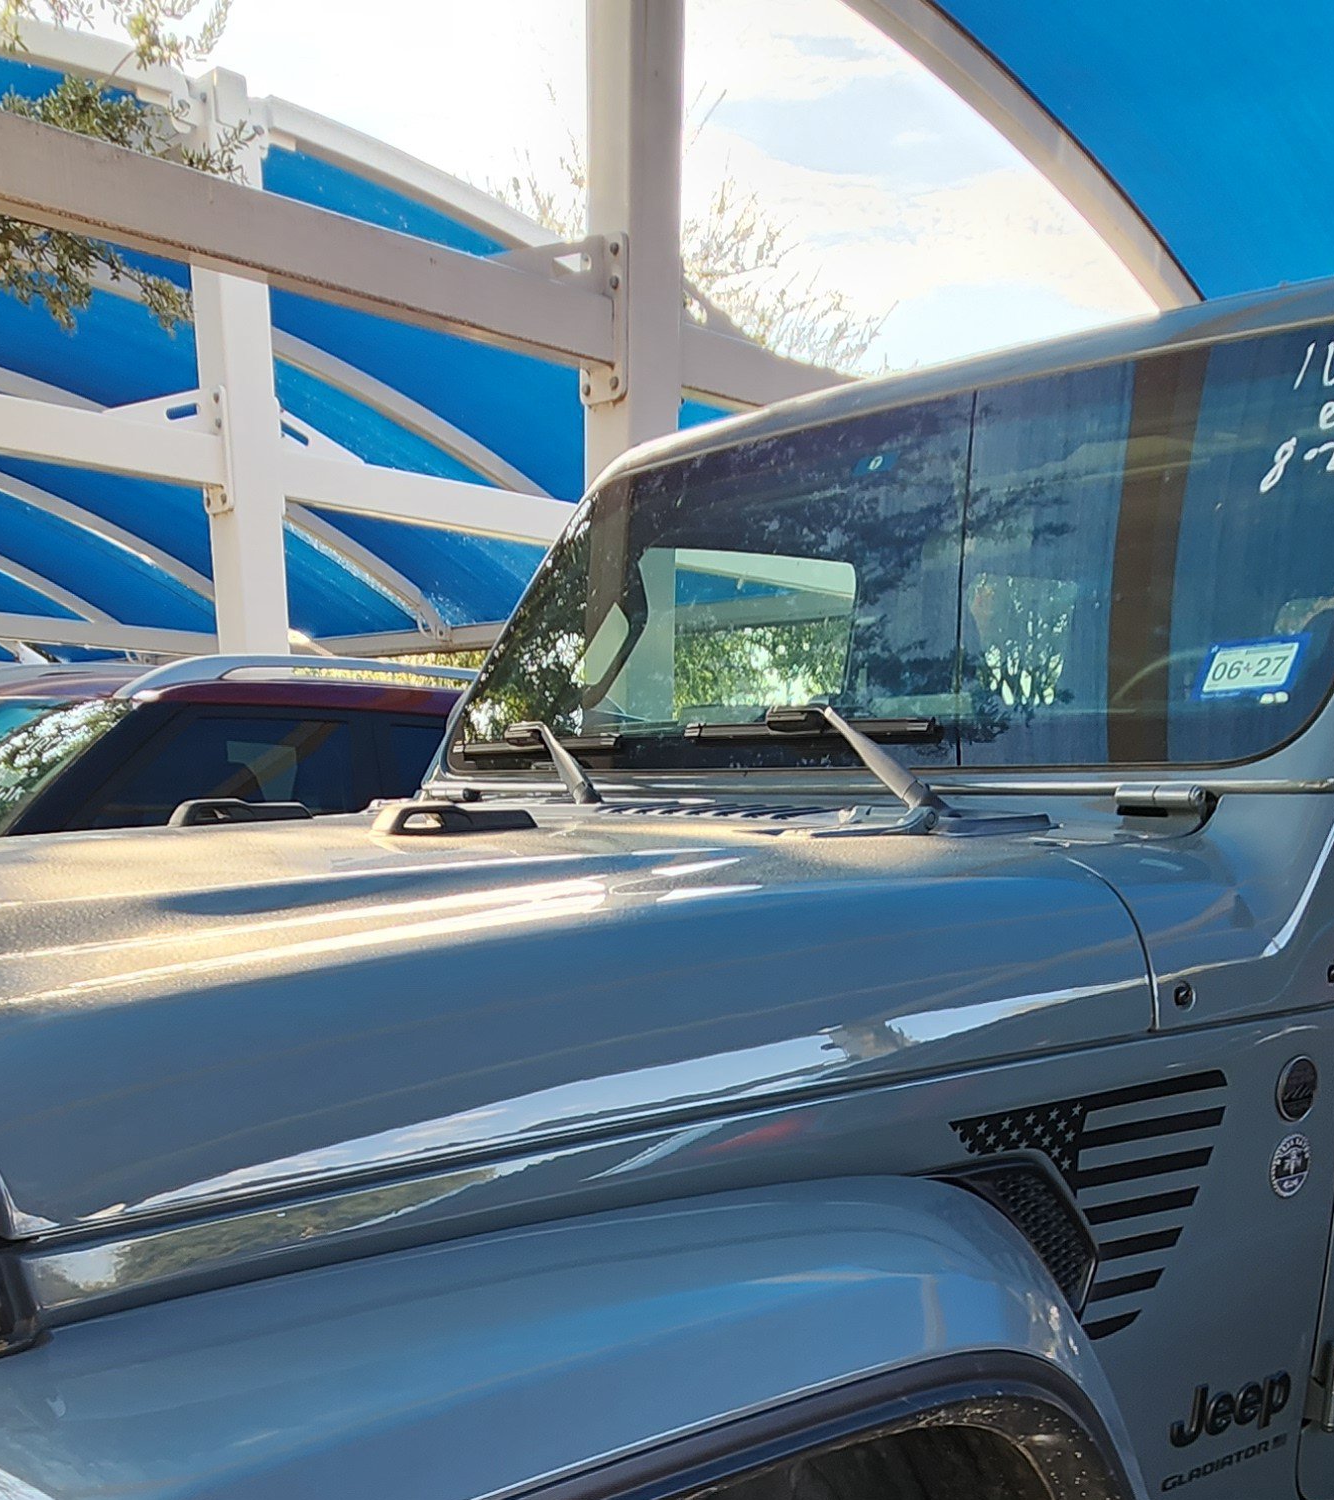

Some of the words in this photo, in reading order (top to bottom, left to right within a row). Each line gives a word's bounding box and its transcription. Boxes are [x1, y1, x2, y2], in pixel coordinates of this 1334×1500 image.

[1211, 660, 1244, 681] 06
[1253, 655, 1290, 677] 27
[1169, 1368, 1292, 1448] Jeep
[1161, 1439, 1270, 1493] GLADIATOR
